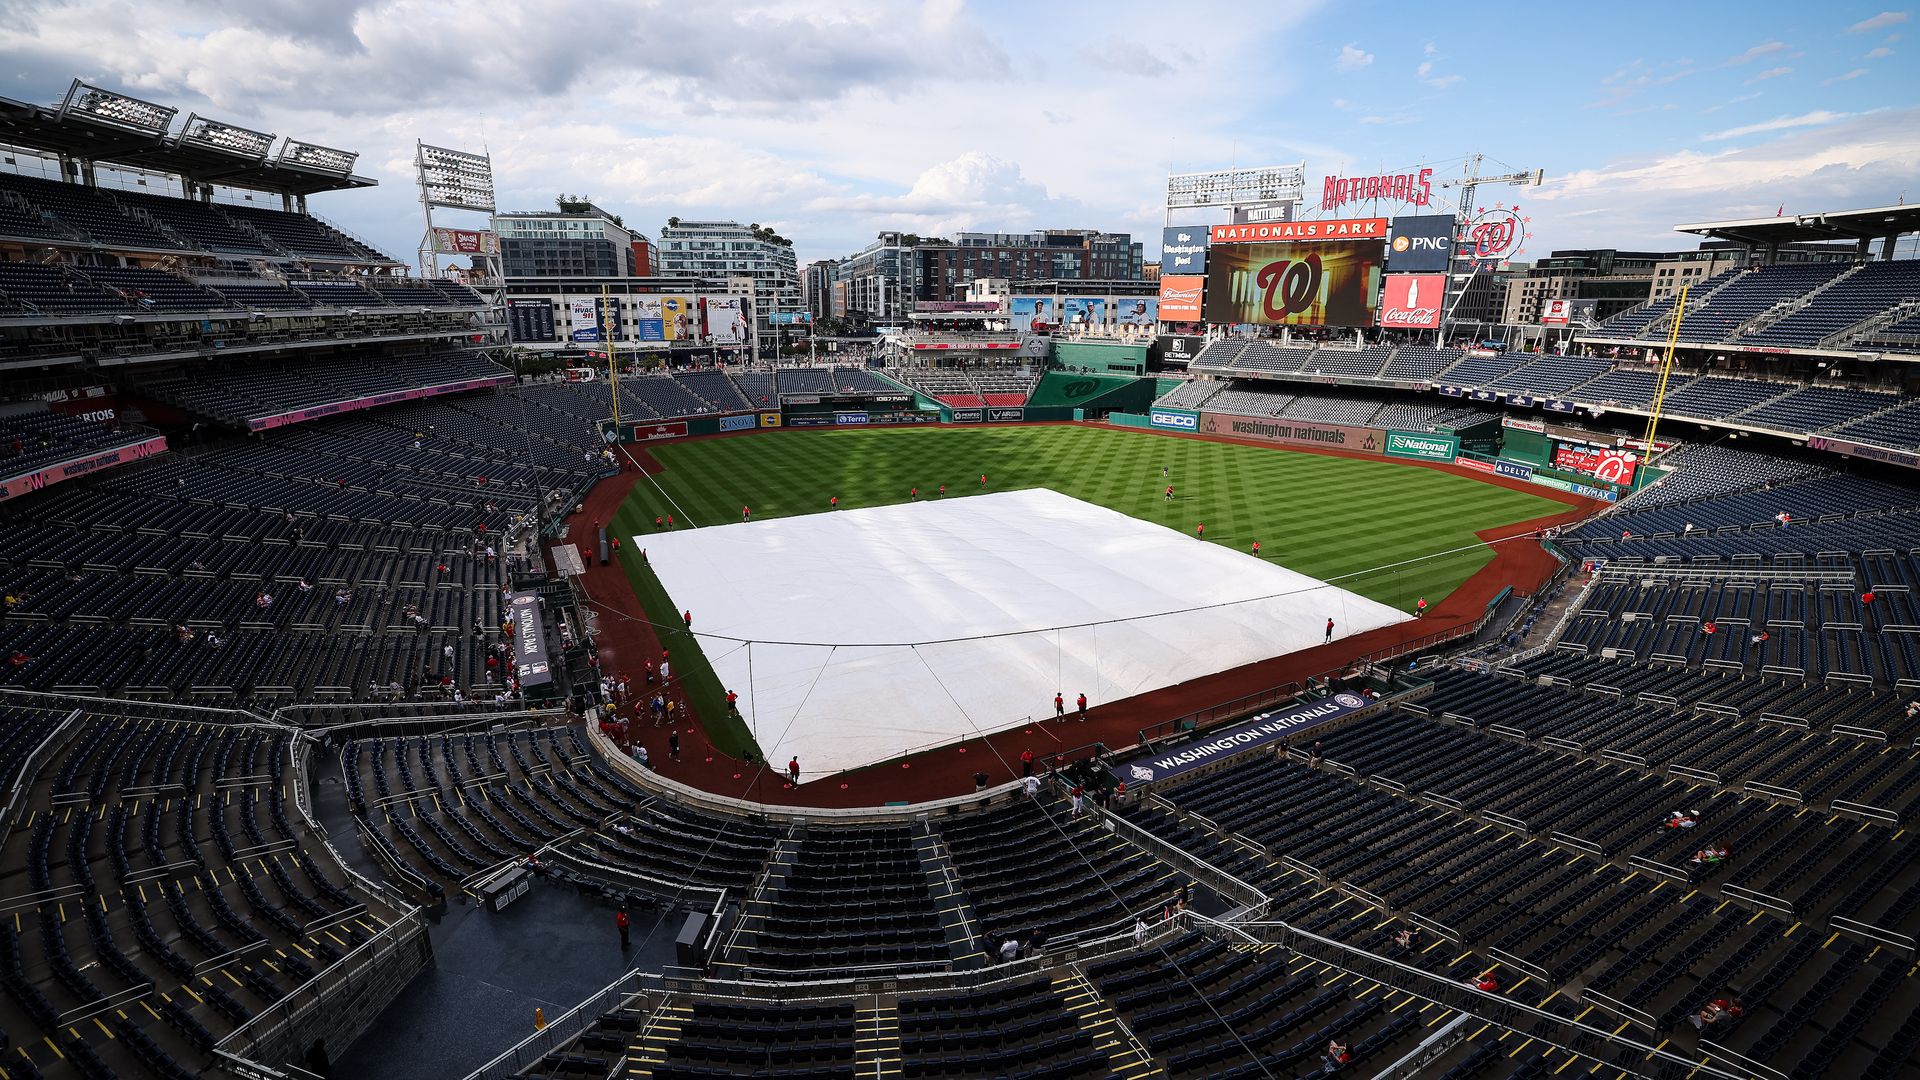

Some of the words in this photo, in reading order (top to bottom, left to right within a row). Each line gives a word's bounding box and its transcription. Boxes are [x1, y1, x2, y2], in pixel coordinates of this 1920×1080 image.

[1322, 168, 1433, 210] NATIONALS
[1247, 206, 1286, 221] NATITUDE
[1178, 233, 1191, 242] The
[1216, 225, 1317, 239] NATIONALS
[1326, 222, 1377, 235] PARK
[1472, 217, 1516, 257] W
[1164, 244, 1205, 255] Washington
[1412, 236, 1448, 250] PNC
[1175, 257, 1191, 267] Post
[1257, 252, 1322, 321] W
[1384, 308, 1438, 325] Coca-Cola
[1164, 351, 1191, 359] BETMGM
[728, 416, 755, 428] INOVA
[1152, 413, 1195, 426] GEICO
[1511, 420, 1526, 429] Harris
[1526, 422, 1543, 432] Teeter
[648, 431, 676, 439] Budweiser
[1232, 420, 1292, 439] washington
[1293, 427, 1346, 444] nationals
[1853, 446, 1888, 460] washington
[63, 459, 97, 477] washington
[1504, 465, 1531, 479] DELTA
[1577, 485, 1611, 500] RE/MAX
[520, 608, 536, 638] NATIONALS
[523, 638, 538, 655] PARK
[1153, 728, 1264, 770] WASHINGTON
[1258, 702, 1341, 735] NATIONALS
